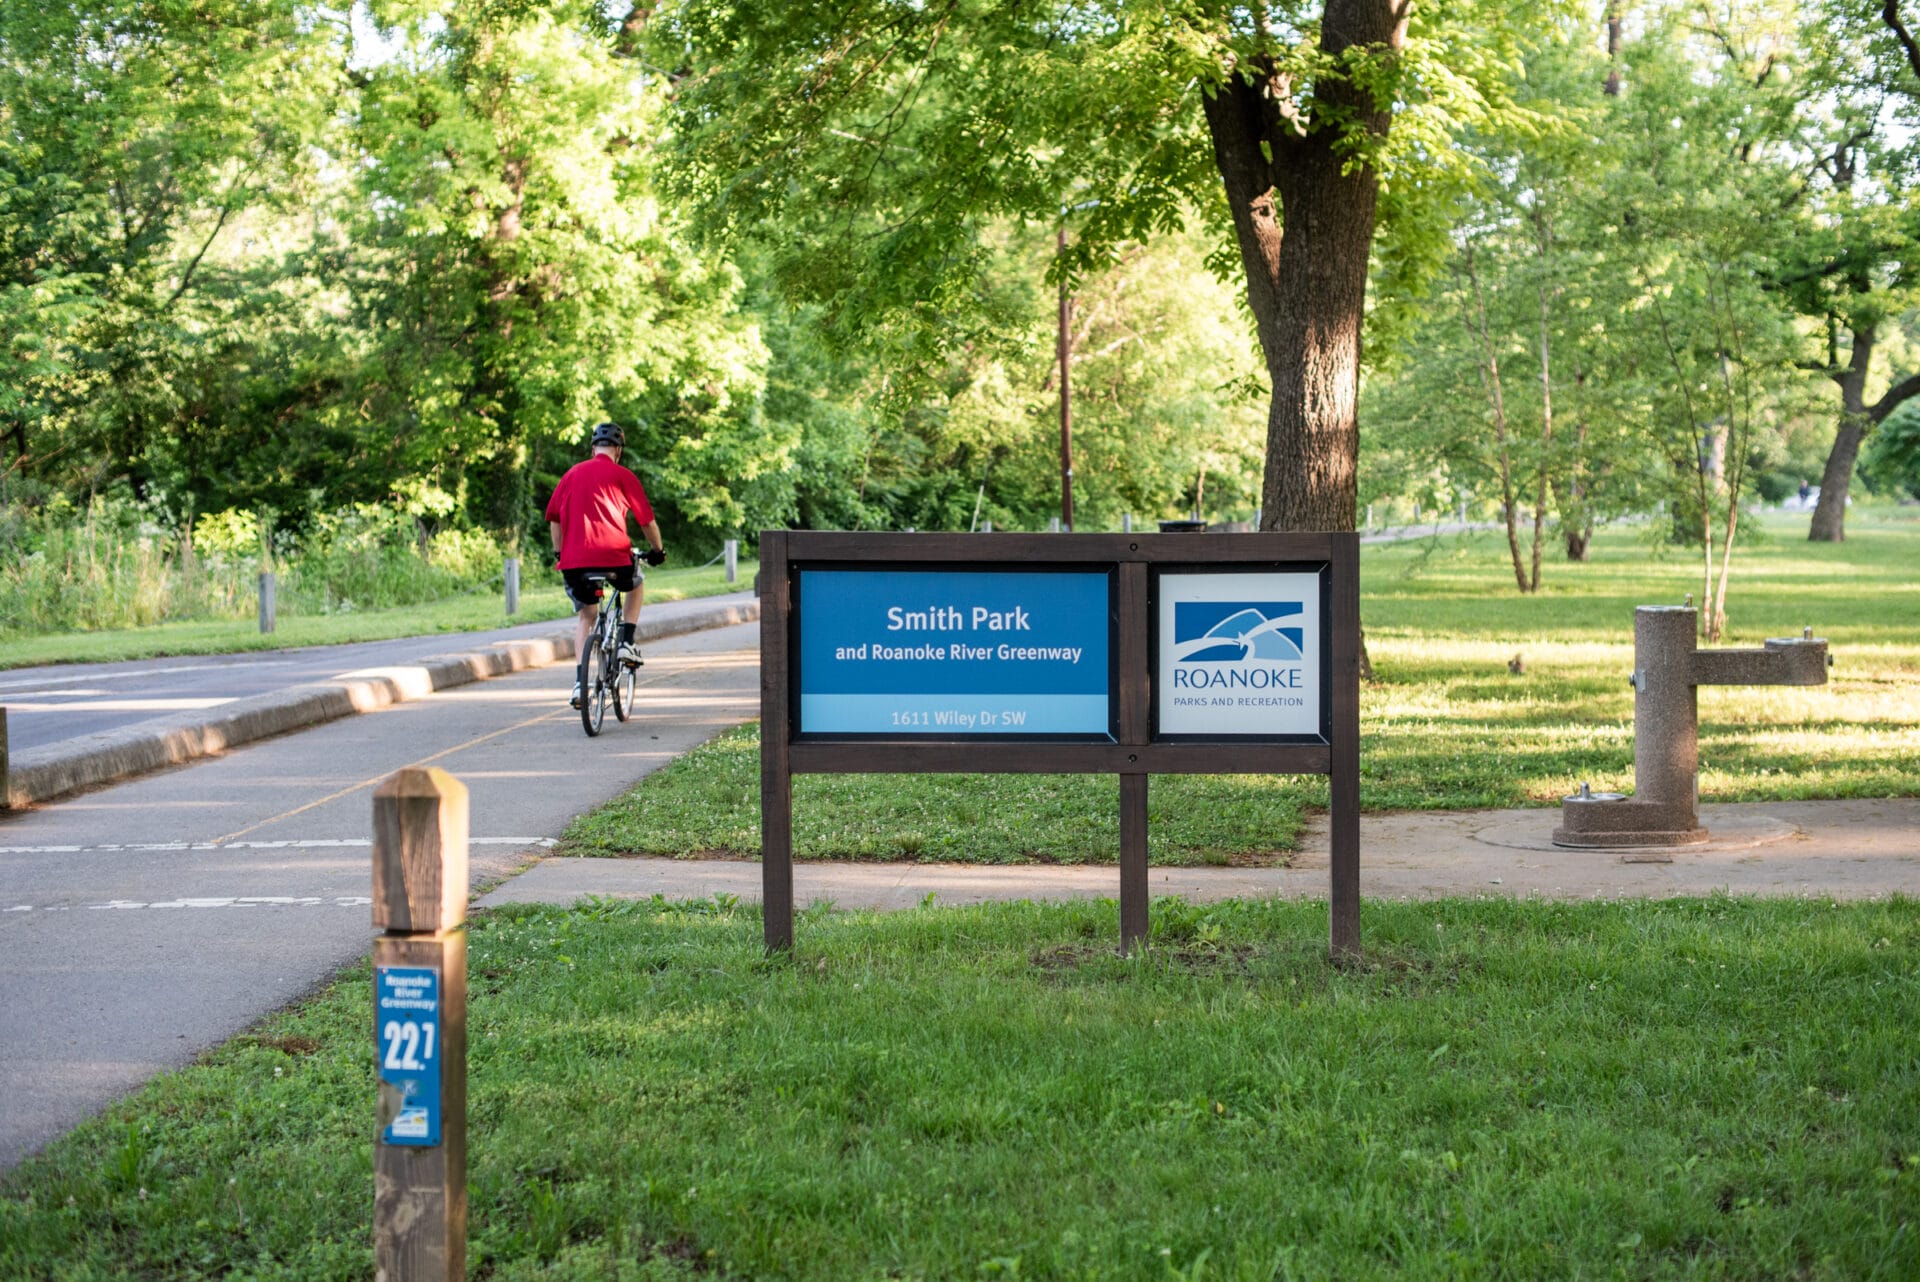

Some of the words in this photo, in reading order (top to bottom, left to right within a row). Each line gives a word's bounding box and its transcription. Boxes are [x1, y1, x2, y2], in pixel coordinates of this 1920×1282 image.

[887, 606, 963, 630] Smith
[972, 606, 1031, 630] Park
[835, 644, 867, 660] and
[872, 644, 946, 660] Roanoke
[950, 644, 994, 660] River
[997, 644, 1082, 664] Greenway
[1174, 668, 1303, 689] ROANOKE
[1174, 697, 1208, 706] PARKS
[1211, 697, 1234, 706] AND
[1238, 697, 1304, 706] RECREATION
[891, 711, 930, 726] 1611
[934, 711, 977, 729] Wiley
[980, 711, 998, 726] Dr
[1001, 711, 1027, 726] SW
[385, 975, 432, 988] Roanoke
[394, 987, 423, 999] River
[381, 996, 435, 1012] Greenway
